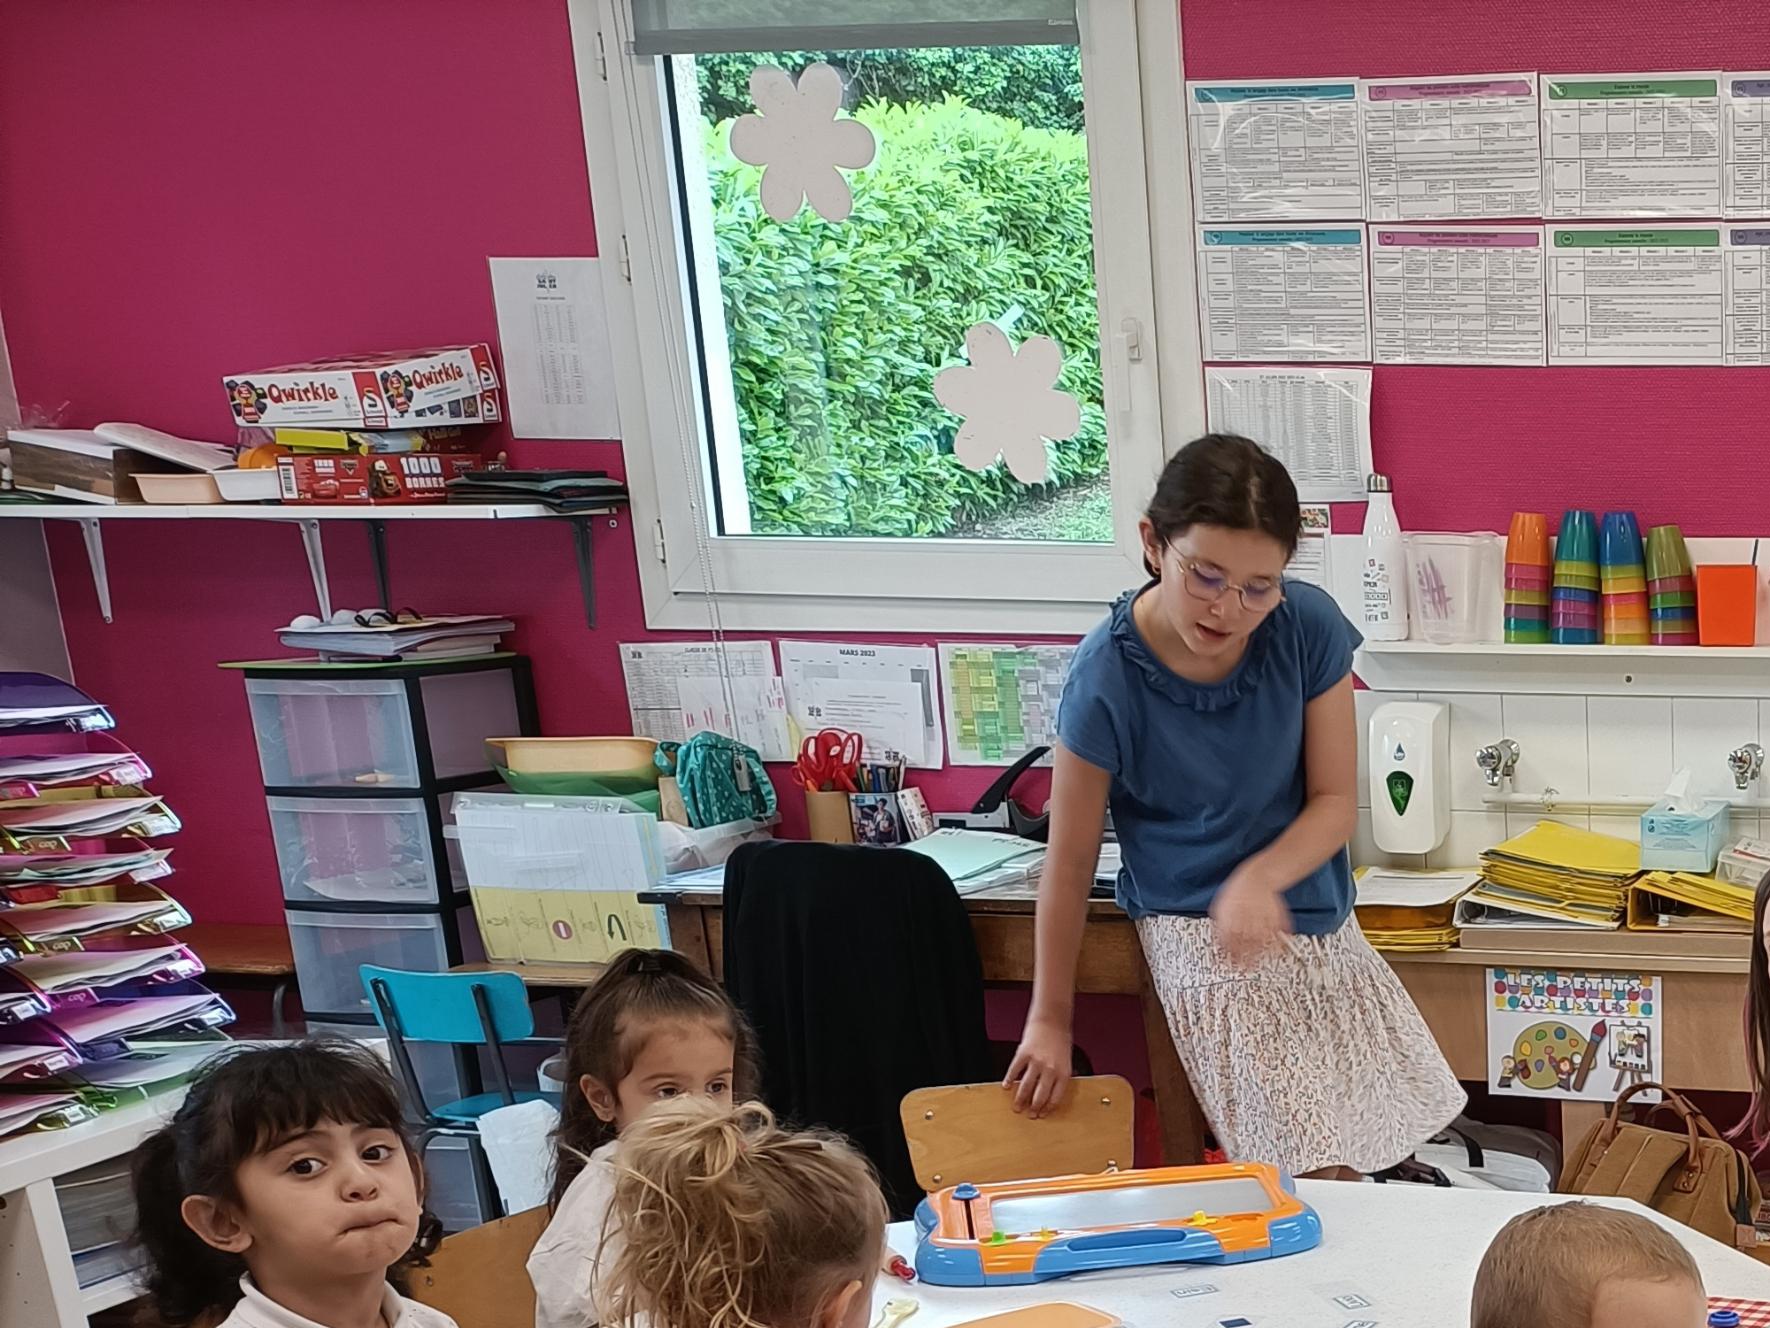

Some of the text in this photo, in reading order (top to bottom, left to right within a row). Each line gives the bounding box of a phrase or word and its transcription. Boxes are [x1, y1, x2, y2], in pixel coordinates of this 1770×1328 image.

[412, 362, 464, 390] Qwirkle
[267, 381, 339, 404] Qwirkle
[400, 457, 442, 475] 1000
[405, 477, 445, 489] BORNES
[839, 649, 876, 657] MARS 2023
[1506, 973, 1642, 992] LES PETITS
[1518, 994, 1632, 1013] ARTISTES
